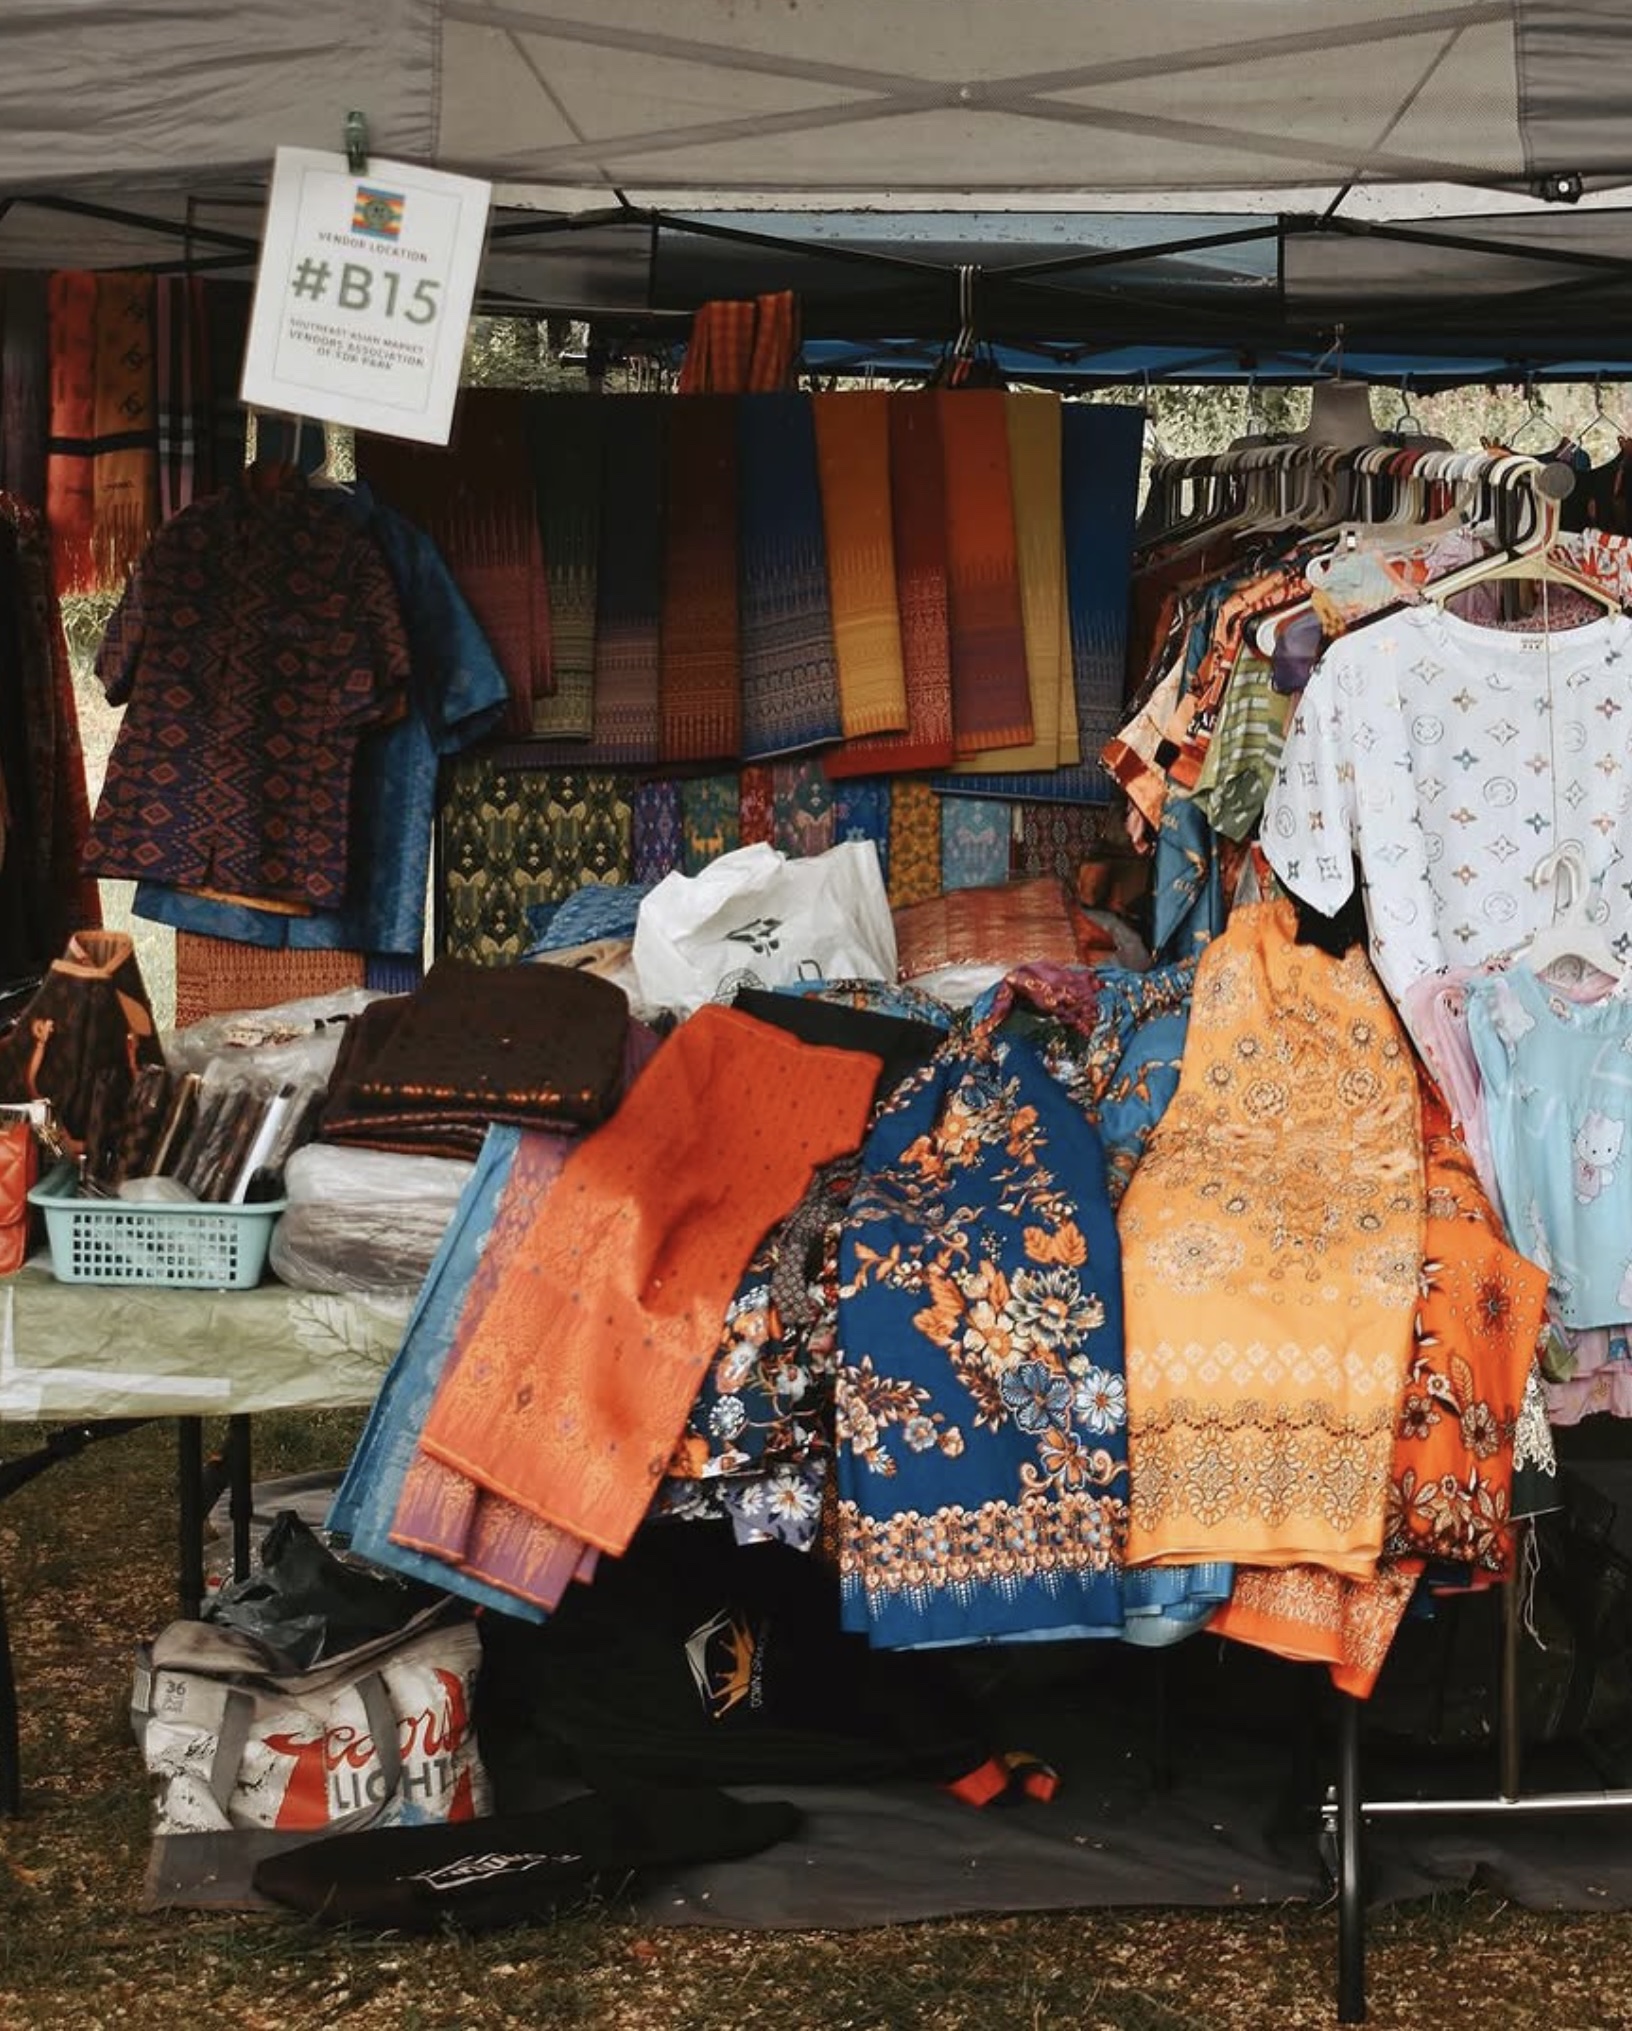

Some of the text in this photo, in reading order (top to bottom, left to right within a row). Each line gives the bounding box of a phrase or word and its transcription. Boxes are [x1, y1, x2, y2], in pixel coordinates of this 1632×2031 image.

[318, 232, 428, 262] VENDOR LOCATION
[291, 257, 441, 325] #B15
[289, 329, 425, 367] VENDORS ASSOCIATION
[290, 317, 424, 354] SOUTHEAST ASIAN MARKET
[317, 347, 332, 357] OF
[361, 358, 394, 370] PARK
[165, 1679, 187, 1696] 36
